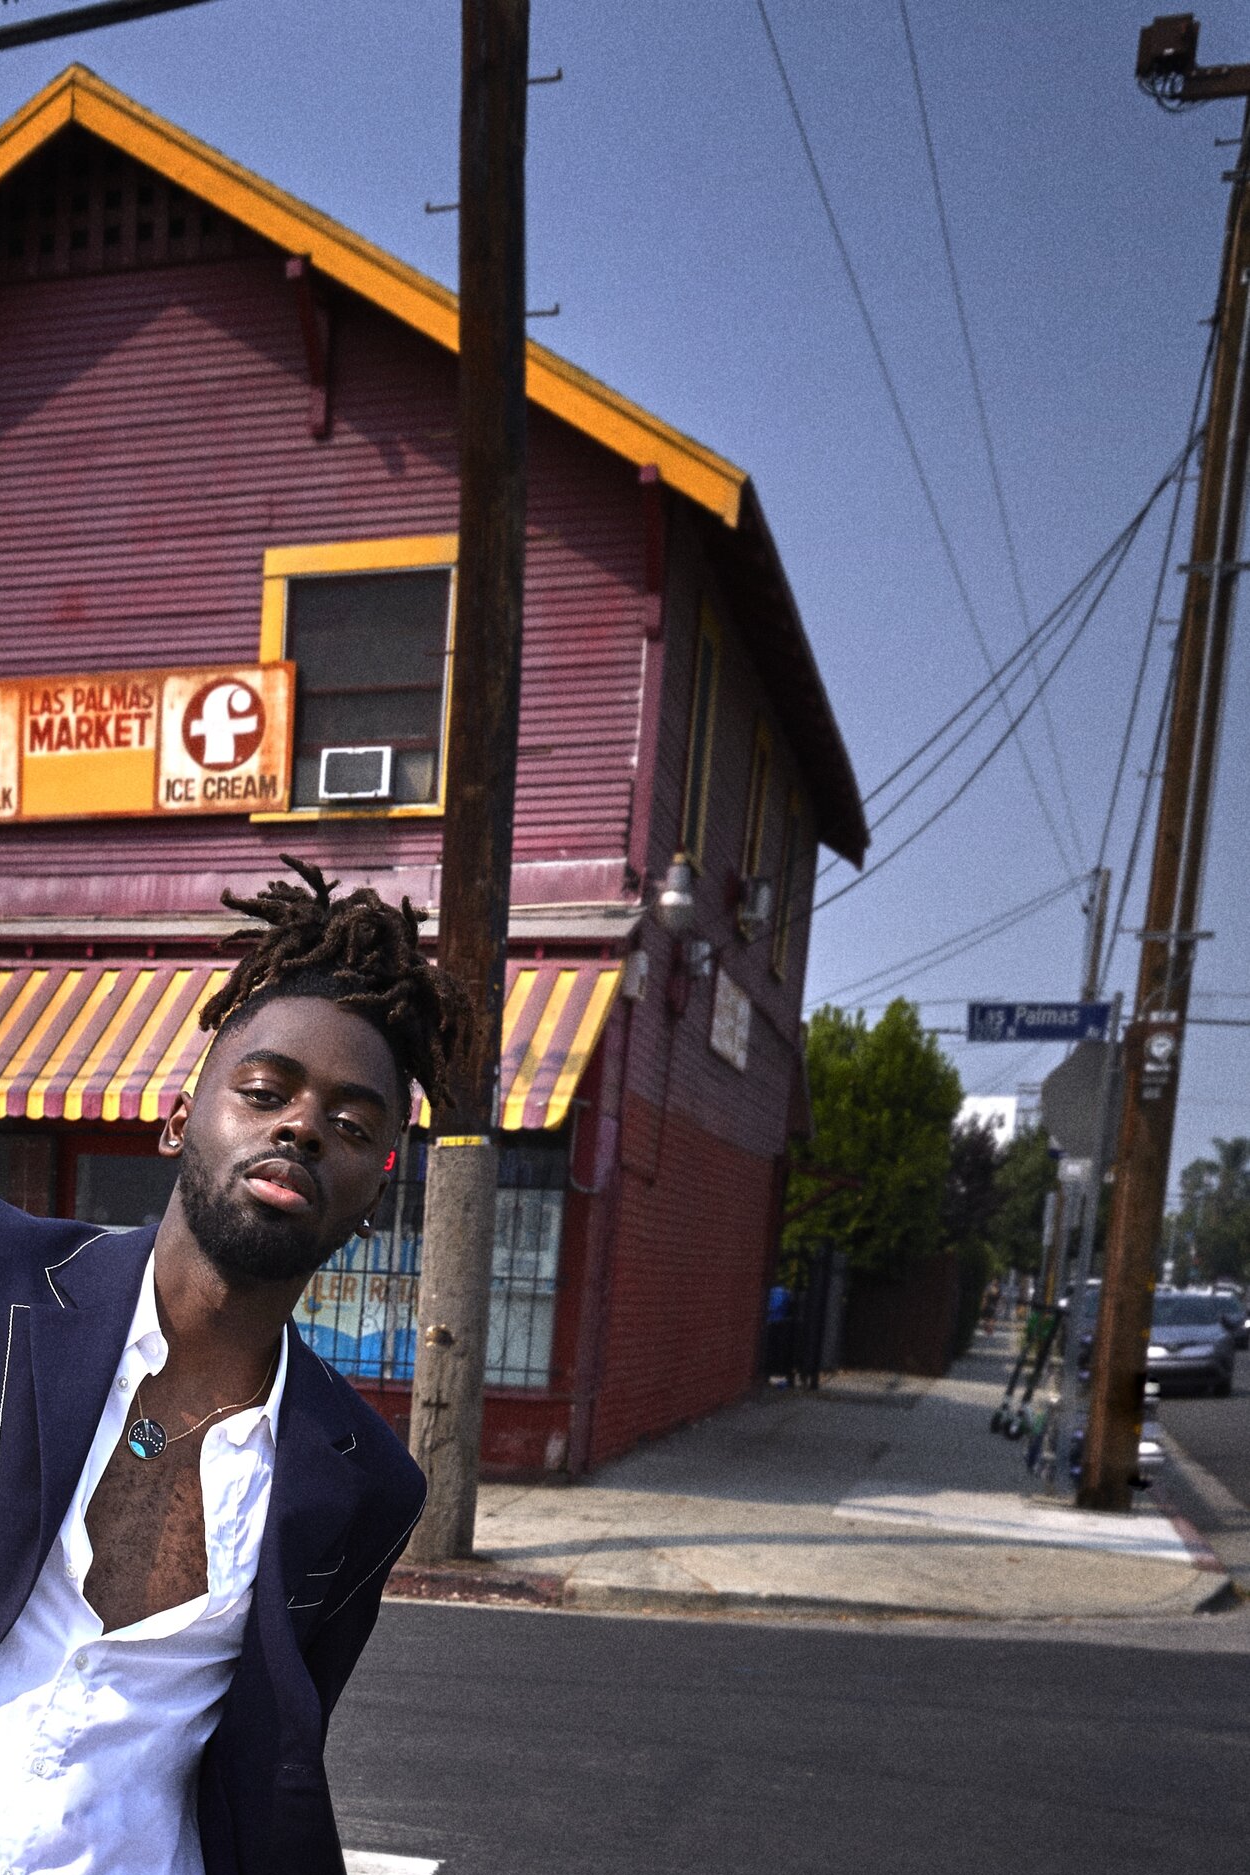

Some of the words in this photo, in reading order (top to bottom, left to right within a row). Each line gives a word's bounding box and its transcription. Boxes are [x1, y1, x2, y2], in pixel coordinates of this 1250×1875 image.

[29, 688, 66, 716] LAS
[72, 683, 155, 714] PALMAS
[29, 711, 152, 753] MARKET
[165, 777, 196, 803] ICE
[202, 774, 278, 801] CREAM
[973, 1004, 1006, 1025] Las
[1014, 1003, 1081, 1026] Palmas
